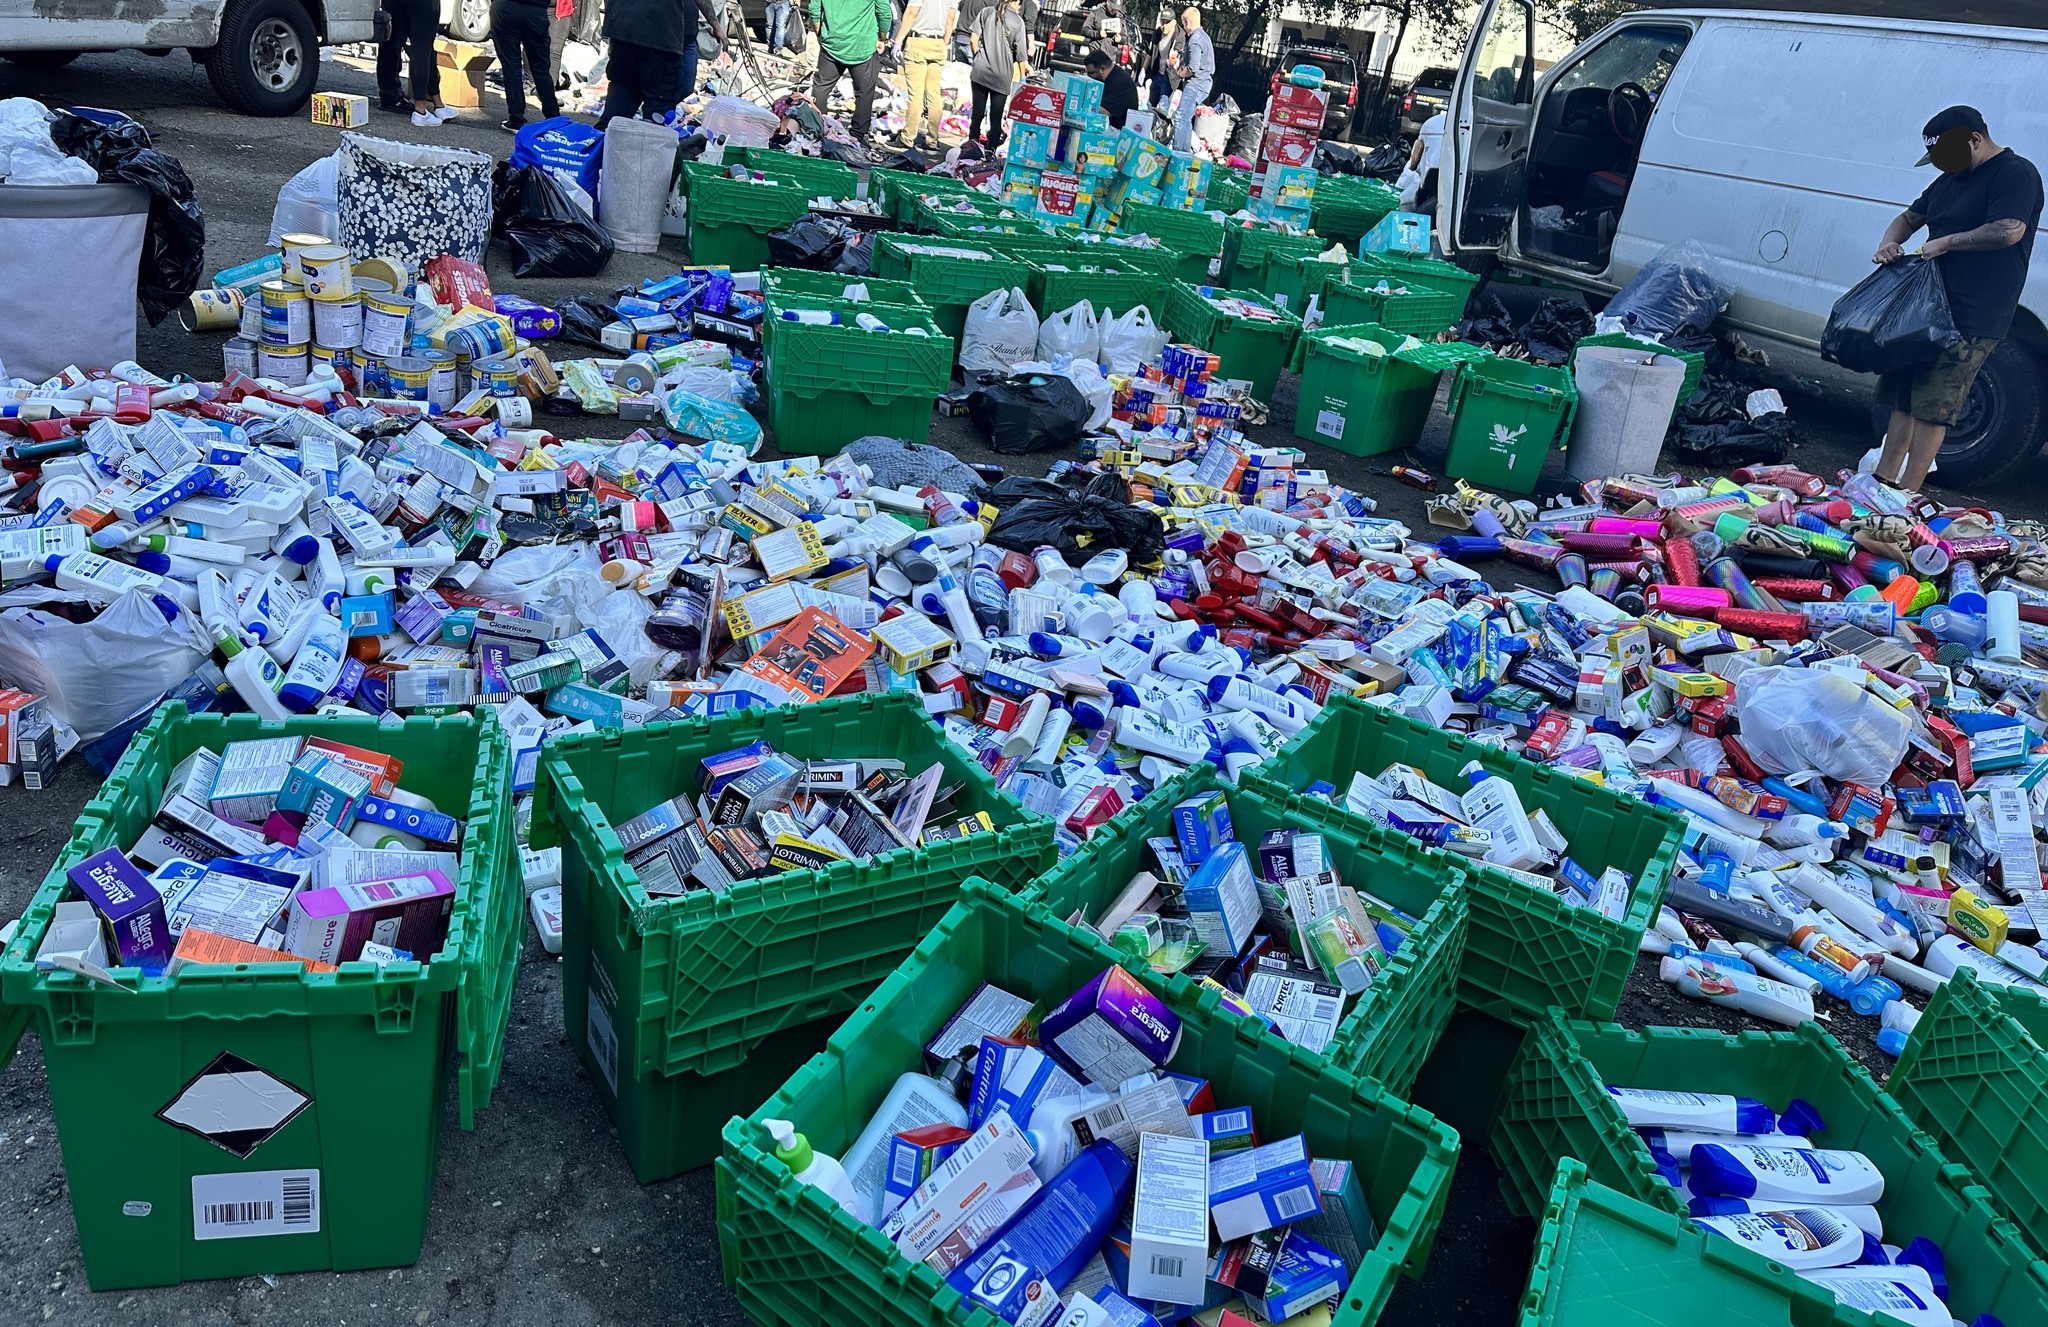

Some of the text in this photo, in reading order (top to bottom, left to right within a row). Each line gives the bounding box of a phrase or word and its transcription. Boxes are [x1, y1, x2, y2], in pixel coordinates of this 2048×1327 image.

[1085, 142, 1110, 154] Pampers
[1010, 172, 1035, 184] Pampers
[1040, 177, 1079, 192] HUGGIES
[1130, 189, 1154, 205] Pampers
[452, 269, 470, 308] UGGIES
[991, 342, 1018, 356] Thank
[390, 386, 416, 397] Similac
[493, 388, 515, 397] Similac
[122, 464, 151, 485] CeraVe
[730, 506, 758, 527] BAYER
[481, 542, 499, 567] CeraVe
[489, 620, 531, 634] Cicatricure
[492, 649, 503, 679] Allegra
[424, 705, 446, 715] Systane
[613, 710, 644, 724] CeraVe
[342, 758, 379, 772] DUAL ACTION
[1868, 791, 1883, 803] Hefty
[1183, 811, 1197, 846] Claritin
[1450, 827, 1490, 841] CeraVe
[722, 849, 747, 876] LOTRIMIN
[773, 846, 824, 870] LOTRIMIN
[89, 866, 129, 905] Allegra
[113, 879, 136, 898] ALLERGY
[136, 913, 155, 950] Allegra
[1956, 911, 1989, 936] Culturelle
[1963, 924, 1981, 940] Kids
[366, 945, 409, 963] CeraVe
[1117, 971, 1143, 996] 90 TABLETS
[1271, 979, 1291, 1013] ZYRTEC
[1131, 1005, 1170, 1042] Allegra
[1150, 1016, 1171, 1034] ALLERGY
[977, 1046, 997, 1104] Claritin
[903, 1207, 936, 1237] Skin Renewing
[908, 1220, 934, 1244] Vitamin
[913, 1228, 939, 1251] Serum
[1248, 1246, 1264, 1266] FUNGI
[1017, 1291, 1052, 1327] revagen
